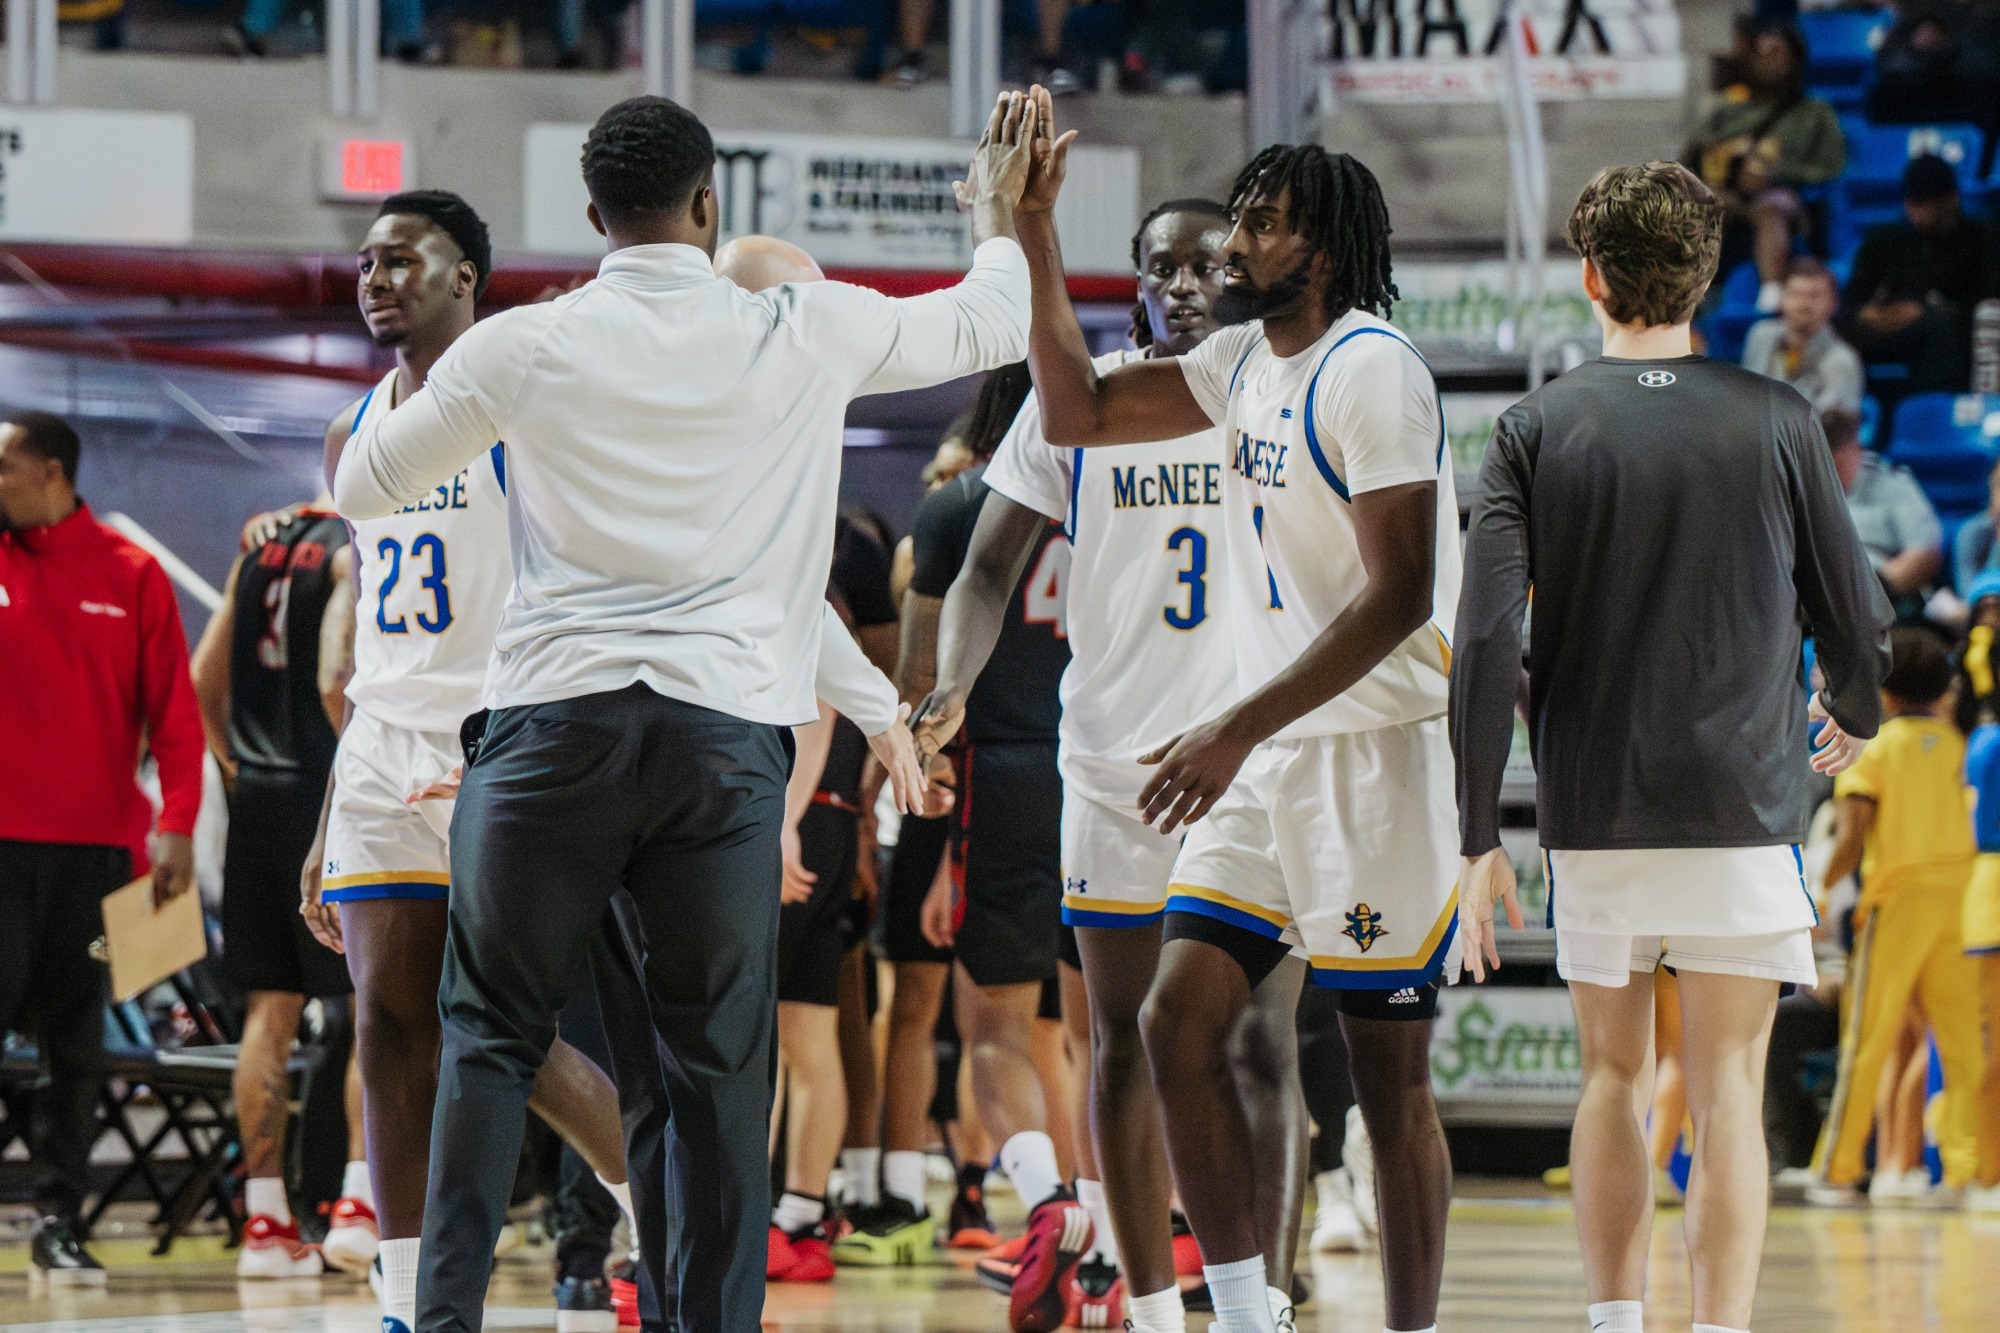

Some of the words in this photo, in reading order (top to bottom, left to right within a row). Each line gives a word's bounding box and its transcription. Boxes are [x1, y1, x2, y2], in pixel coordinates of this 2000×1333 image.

[1111, 462, 1222, 509] McNEE
[375, 532, 455, 636] 23
[1162, 524, 1210, 633] 3
